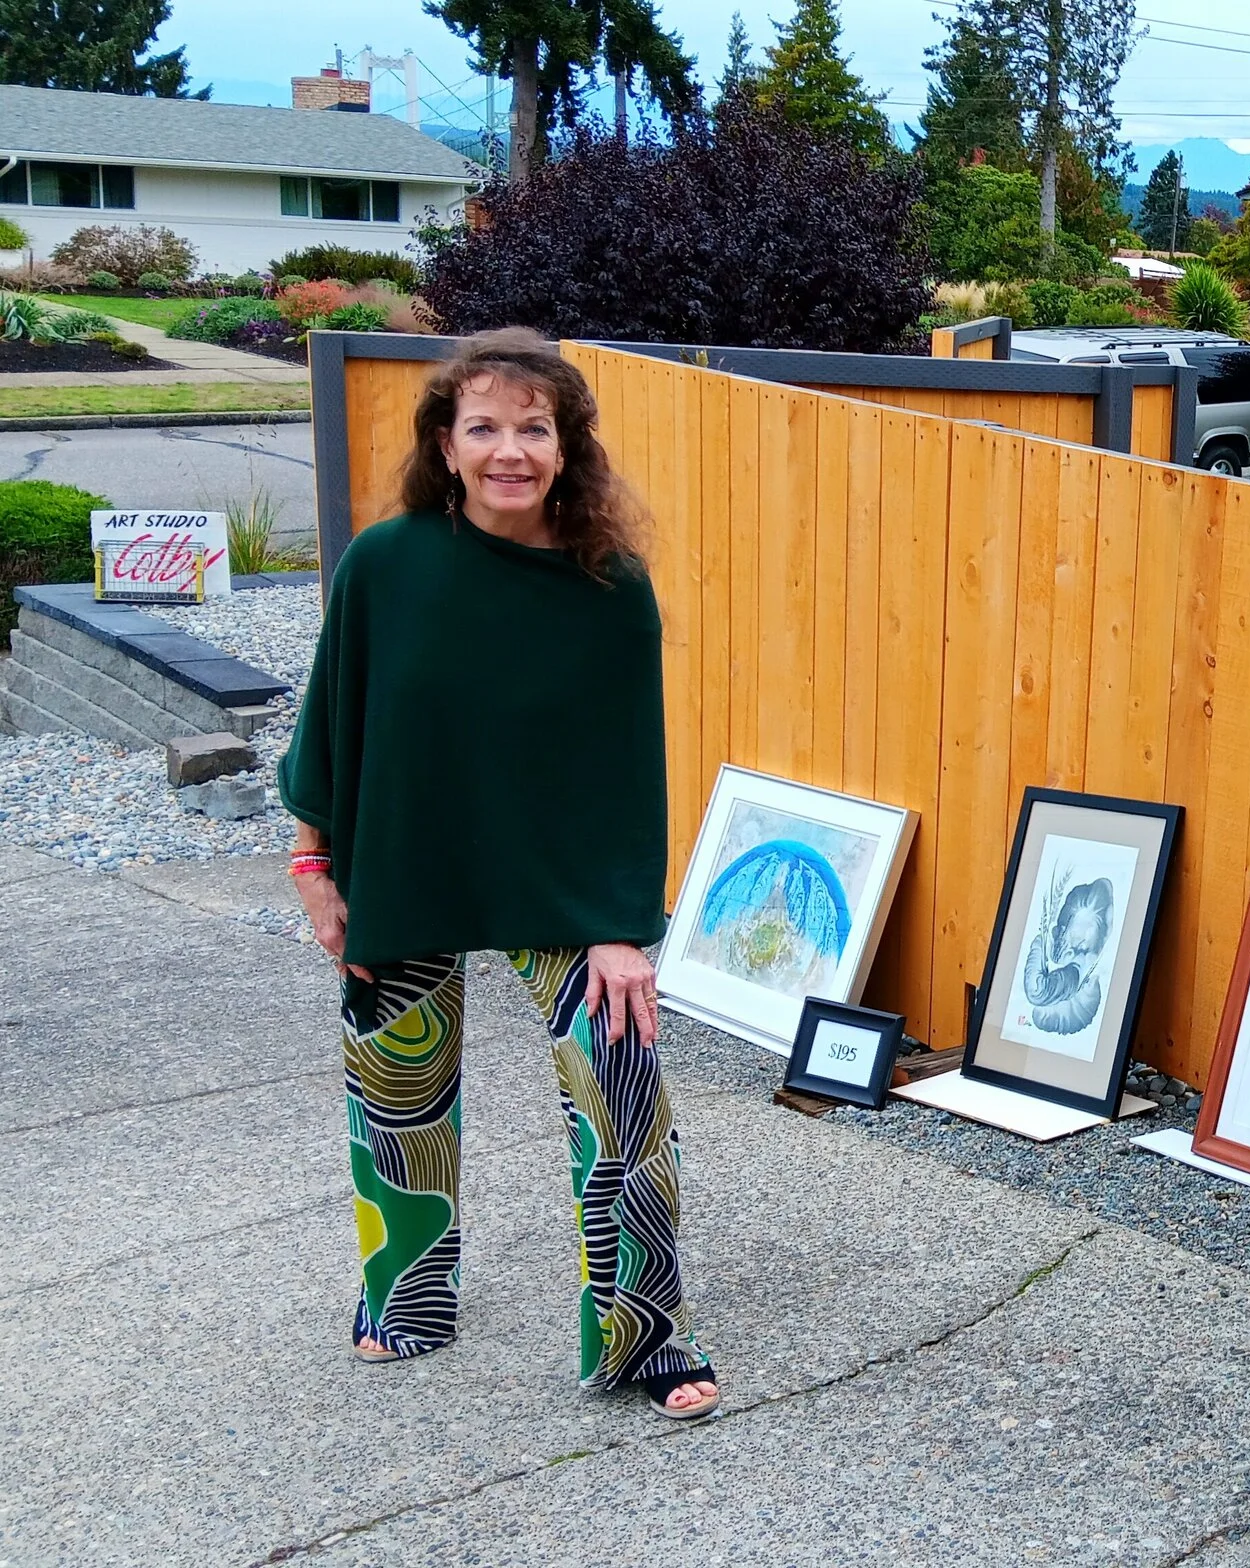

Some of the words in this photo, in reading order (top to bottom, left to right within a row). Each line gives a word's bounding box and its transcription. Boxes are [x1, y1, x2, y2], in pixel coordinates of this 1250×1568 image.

[105, 514, 139, 528] ART
[145, 515, 208, 528] STUDIO
[828, 1042, 858, 1062] $195
